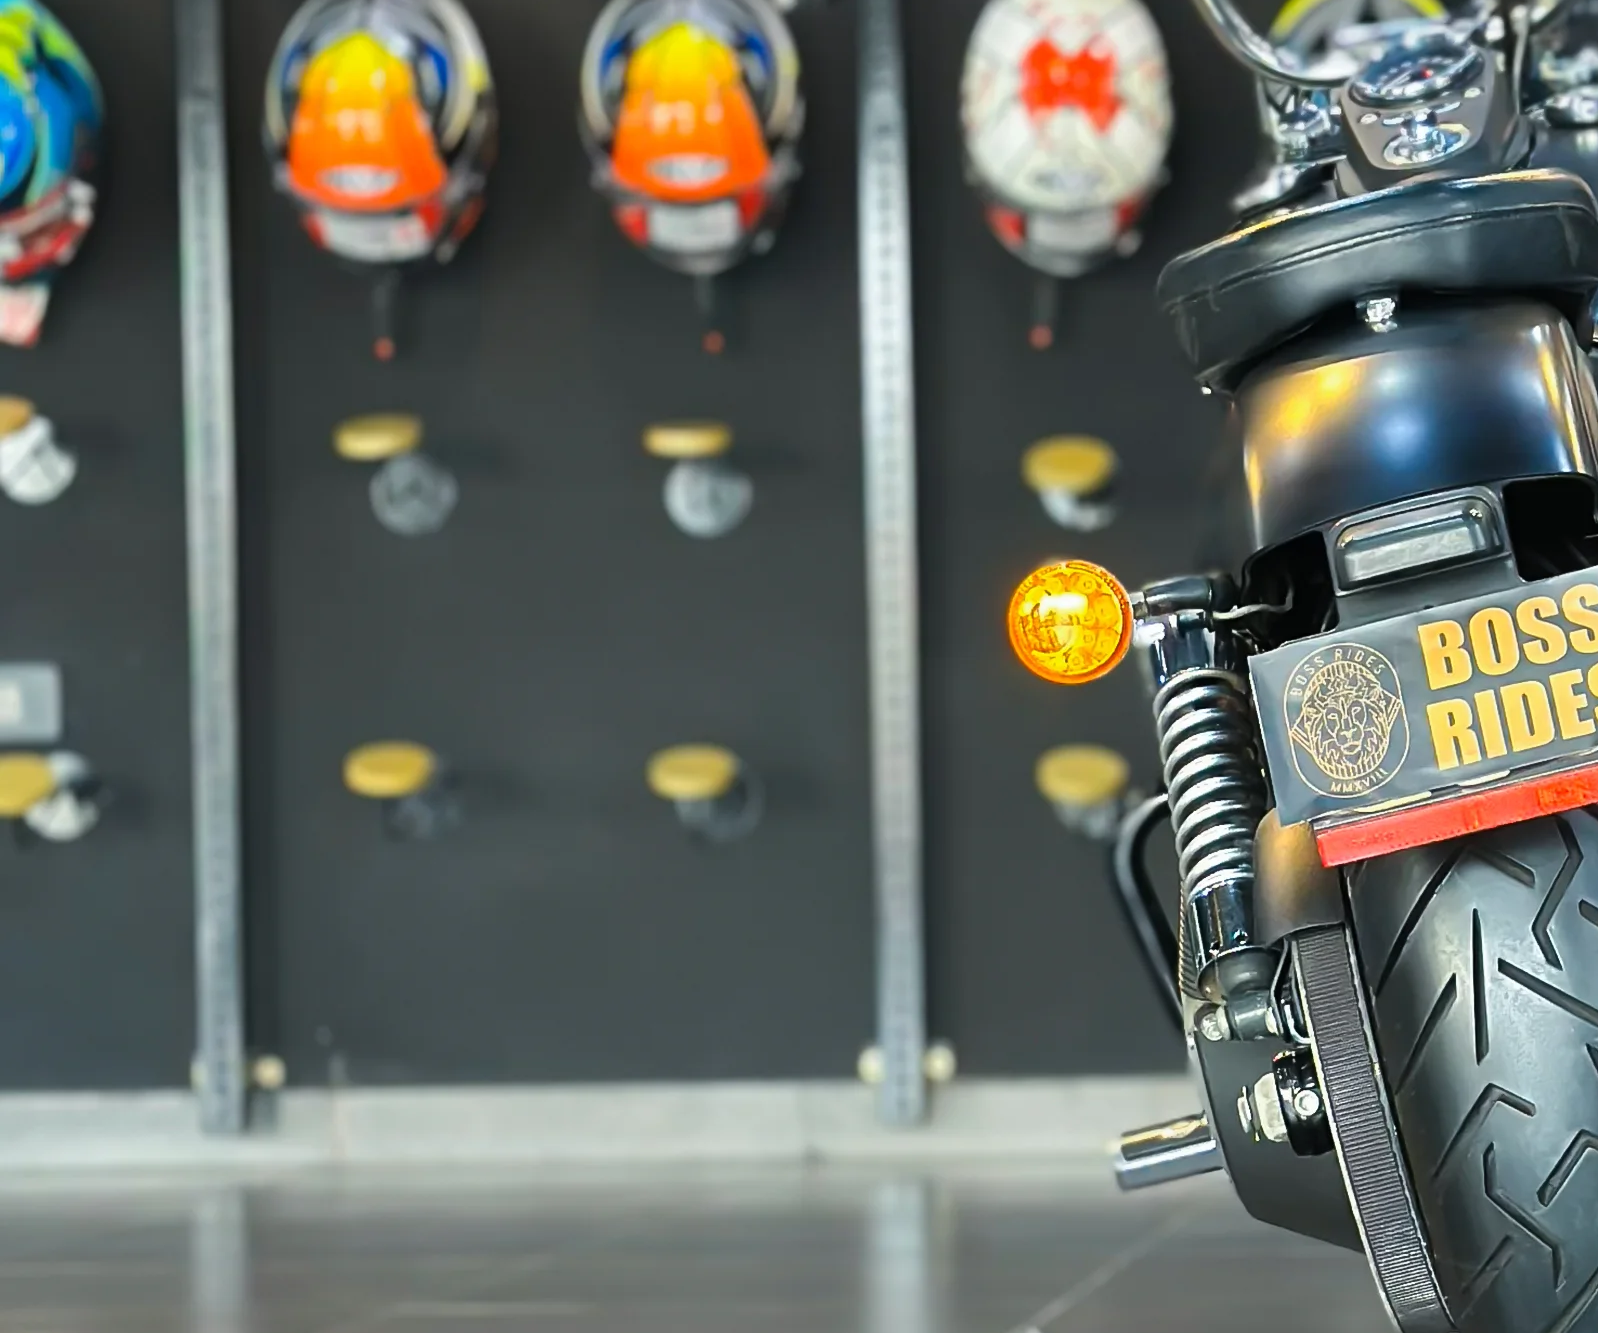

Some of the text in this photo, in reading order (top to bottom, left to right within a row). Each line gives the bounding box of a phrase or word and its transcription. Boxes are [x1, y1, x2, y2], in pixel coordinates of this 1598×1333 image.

[1289, 648, 1386, 697] BOSS RIDES
[1330, 767, 1390, 793] MMXVIII
